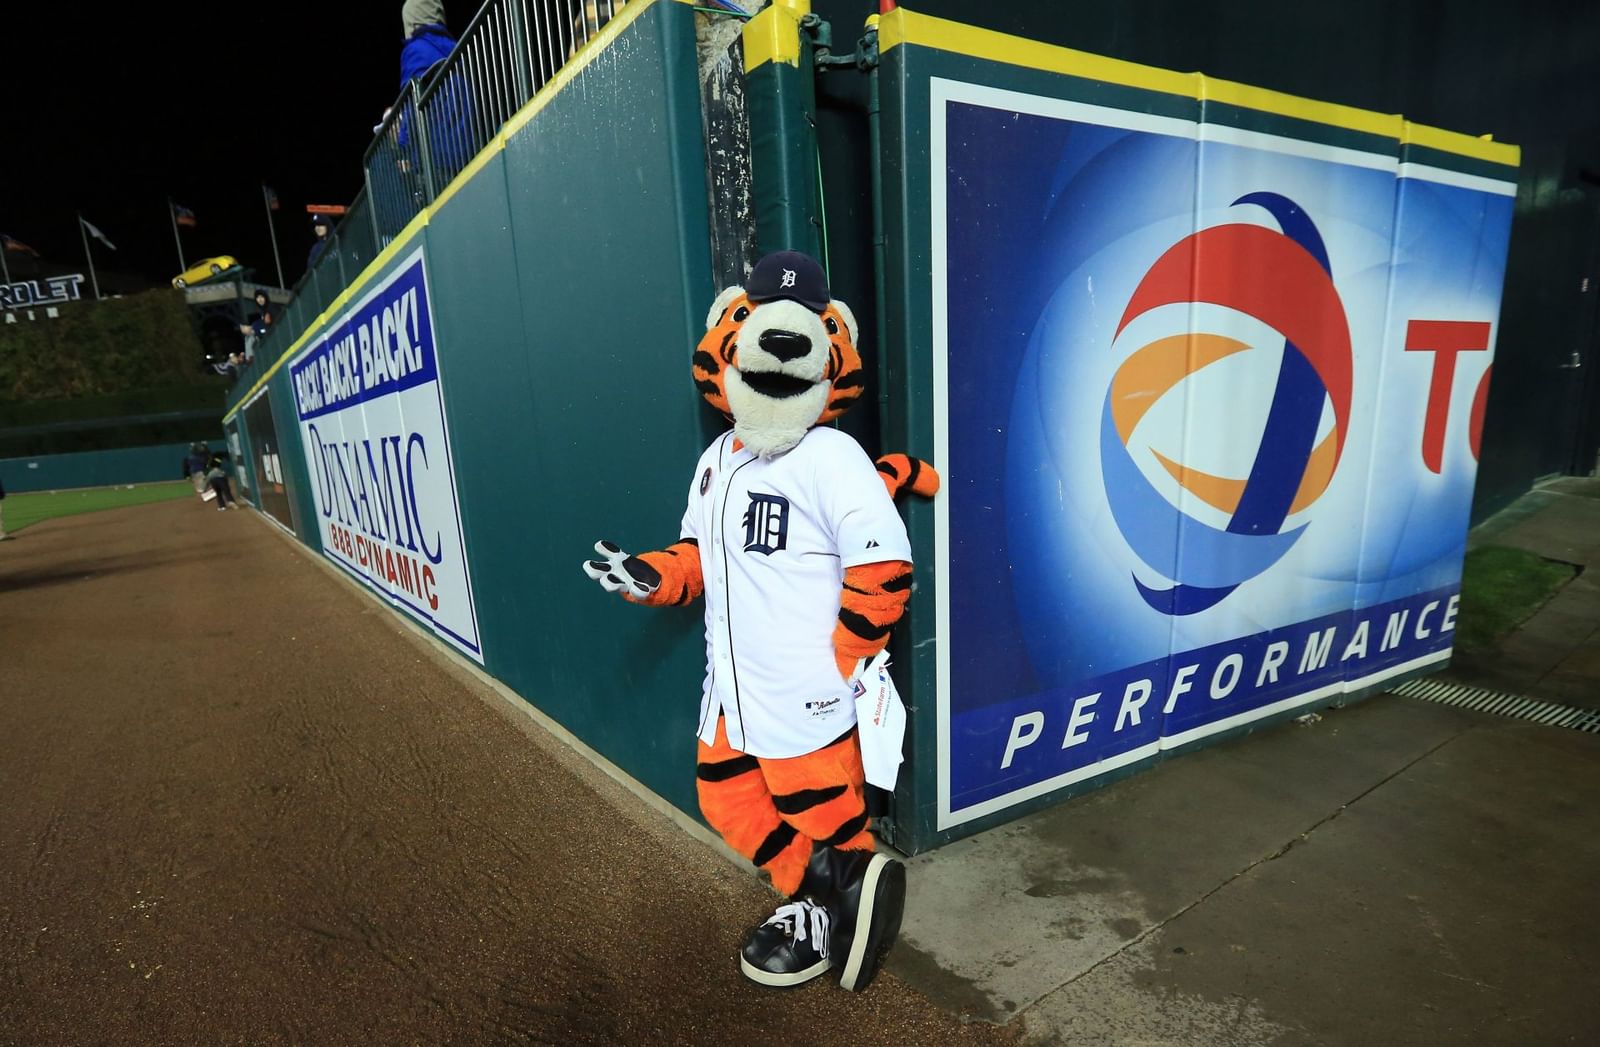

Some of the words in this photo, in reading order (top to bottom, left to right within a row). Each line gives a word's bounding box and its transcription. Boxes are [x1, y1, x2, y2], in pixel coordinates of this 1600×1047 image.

[295, 360, 324, 414] BACK!
[319, 333, 360, 406] BACK!
[358, 286, 423, 390] BACK!
[308, 423, 443, 565] DYNAMIC
[355, 534, 439, 611] DYNAMIC
[1000, 594, 1460, 770] PERFORMANCE
